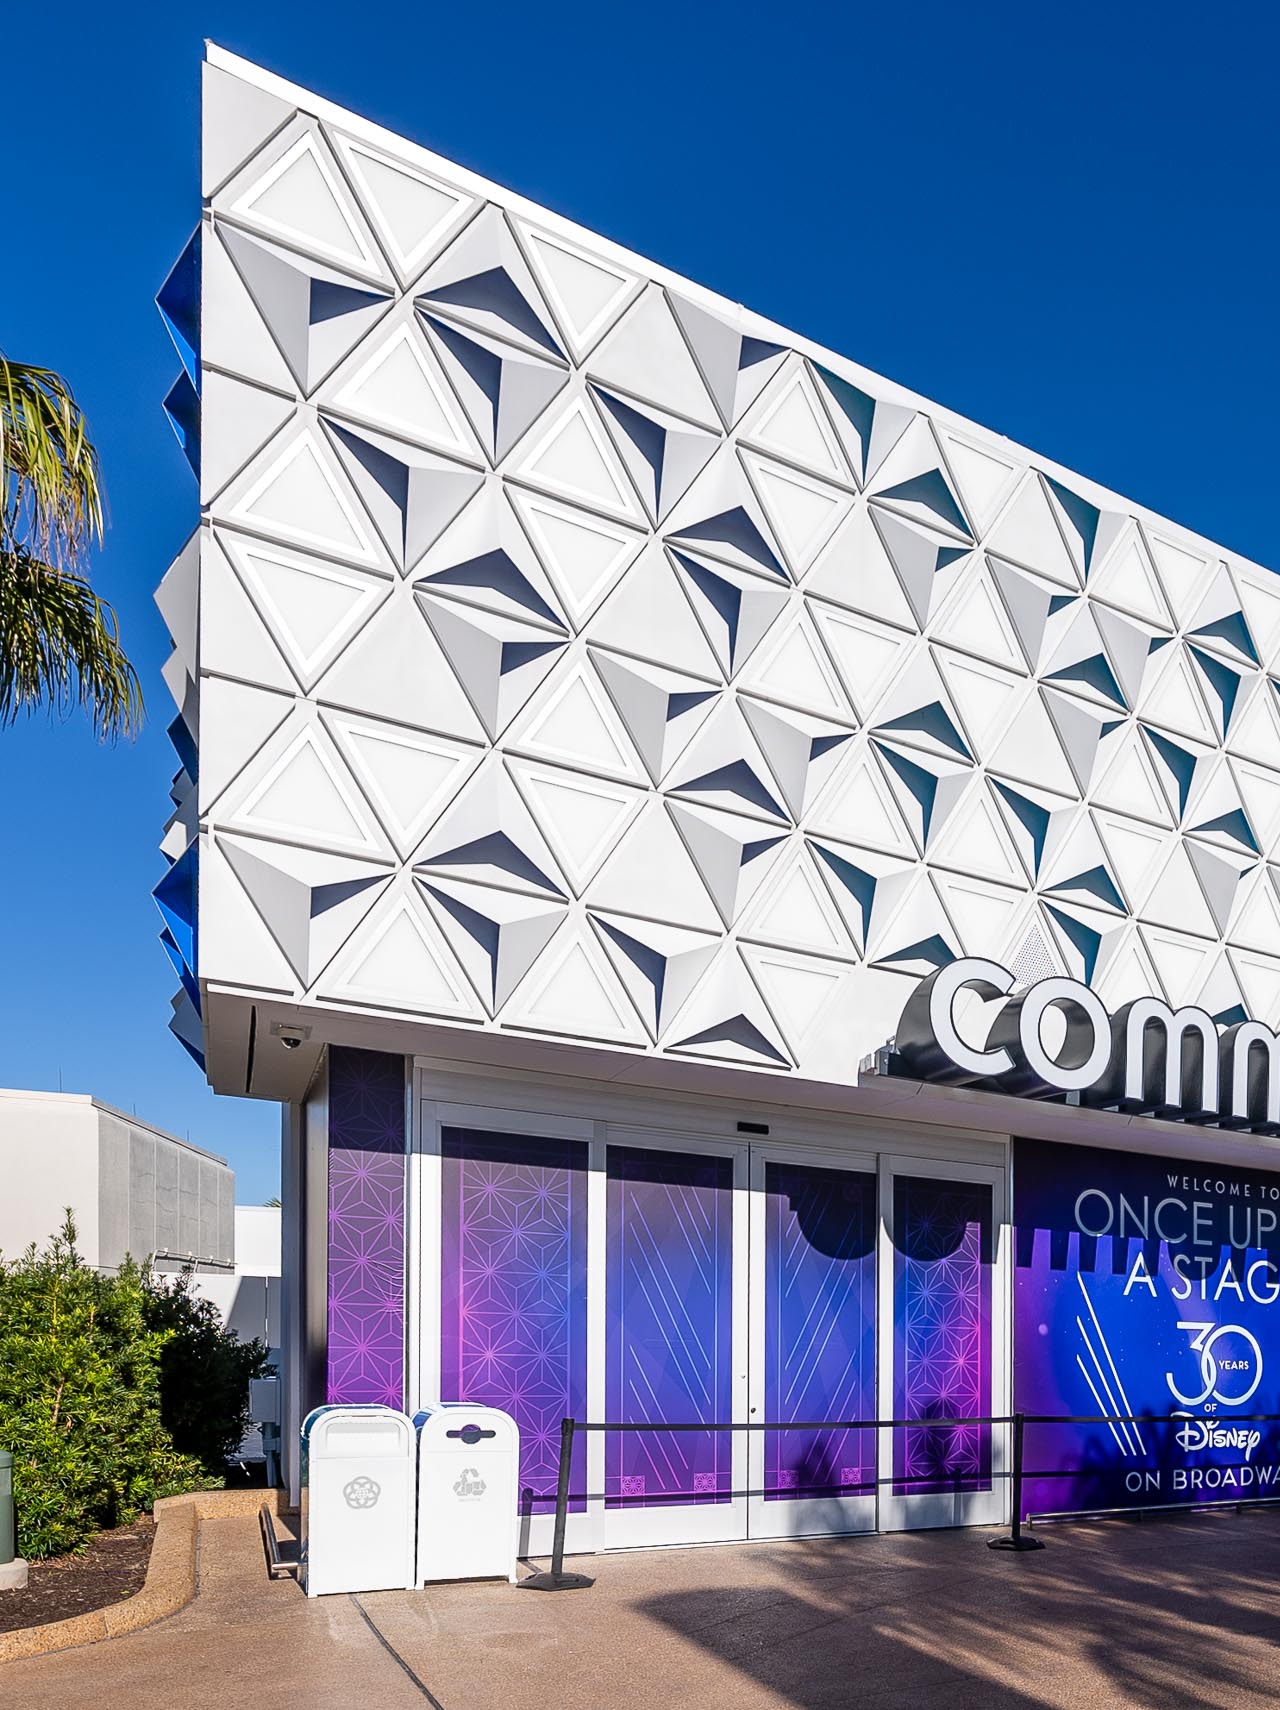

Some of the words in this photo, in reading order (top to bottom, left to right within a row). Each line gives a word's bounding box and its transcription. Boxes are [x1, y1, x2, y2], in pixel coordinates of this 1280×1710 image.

[1167, 1174, 1250, 1197] WELCOME
[1260, 1186, 1280, 1201] TO
[1074, 1188, 1213, 1246] ONCE
[1123, 1251, 1157, 1297] A
[1166, 1321, 1263, 1406] 30
[1218, 1359, 1249, 1371] YEARS
[1203, 1403, 1218, 1413] OF
[1125, 1470, 1161, 1493] ON
